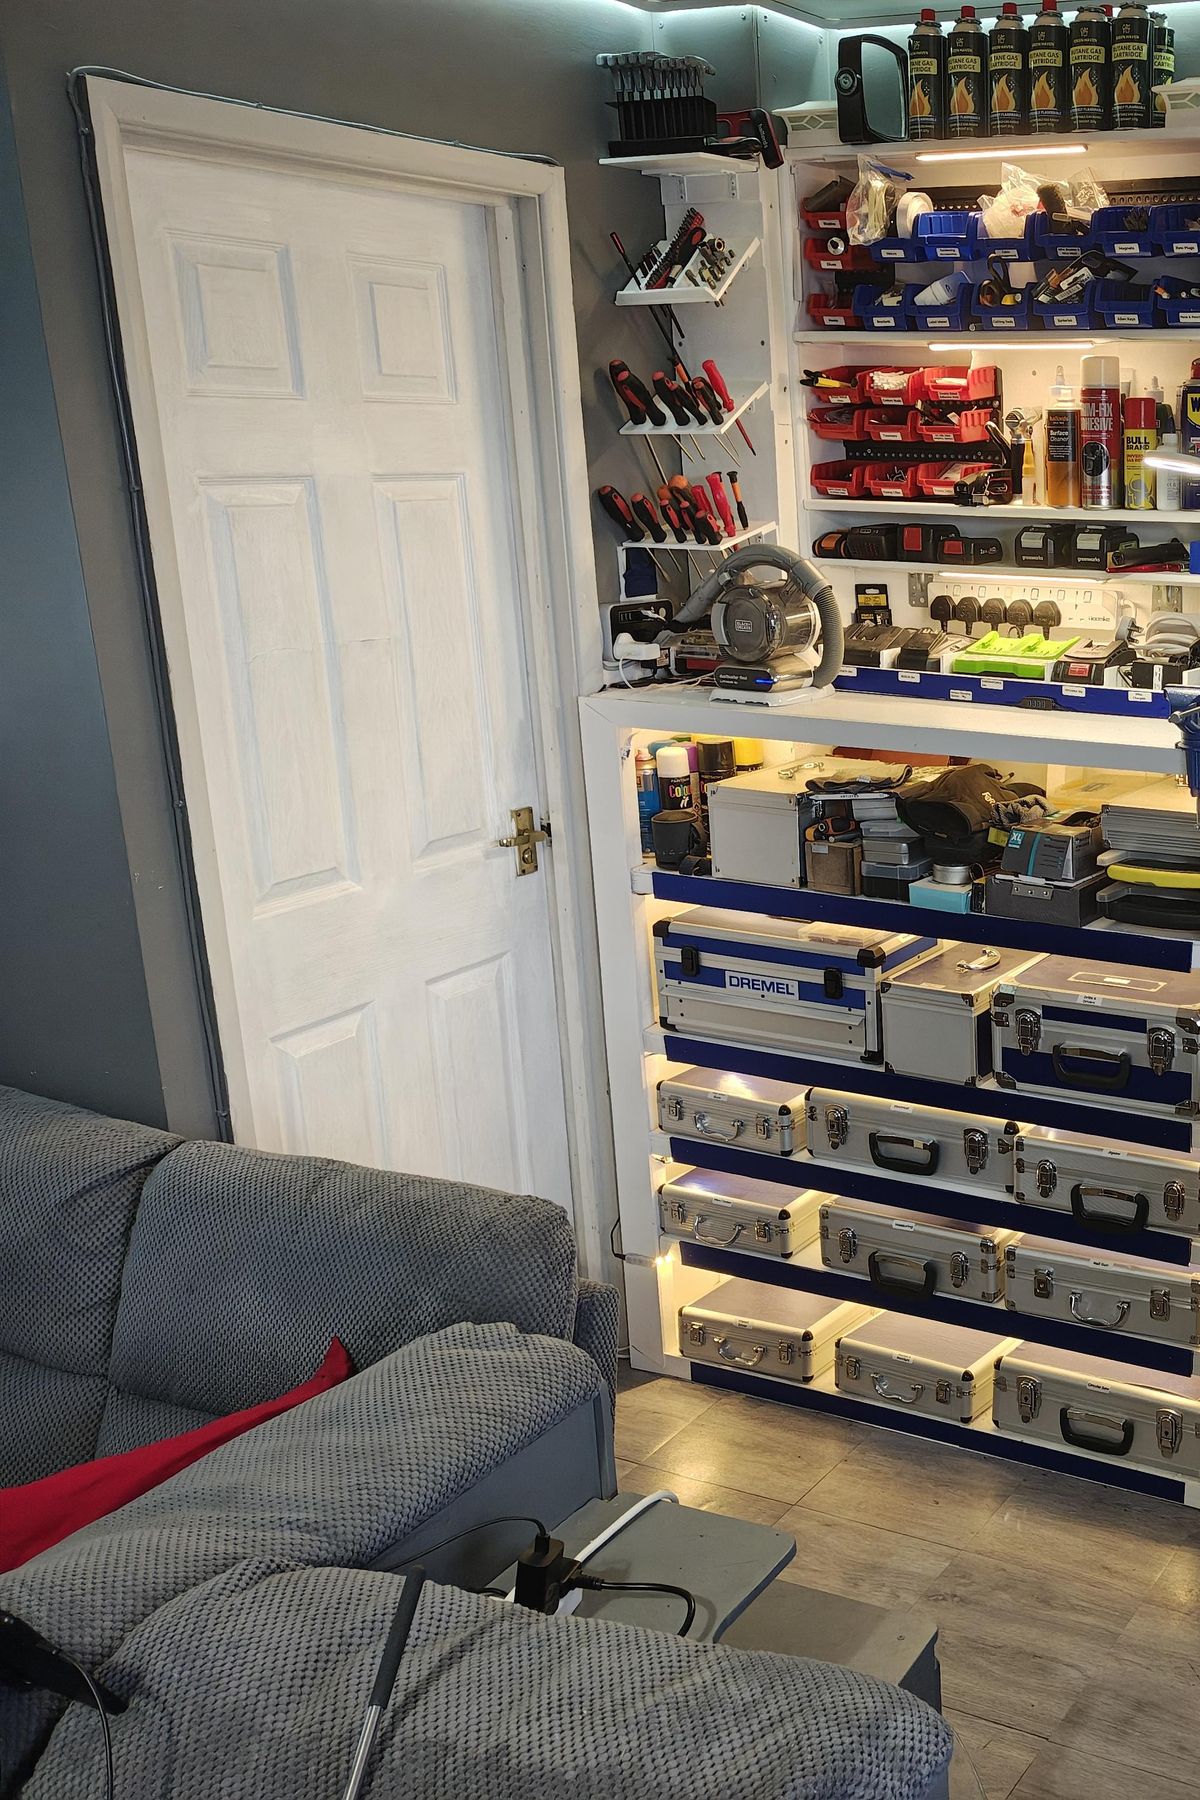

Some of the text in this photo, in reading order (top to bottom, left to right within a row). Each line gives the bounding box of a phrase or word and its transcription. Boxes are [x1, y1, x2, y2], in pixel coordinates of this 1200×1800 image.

[1126, 436, 1150, 444] BULL
[680, 796, 690, 808] it
[1011, 832, 1022, 840] XL
[729, 975, 794, 996] DREMEL
